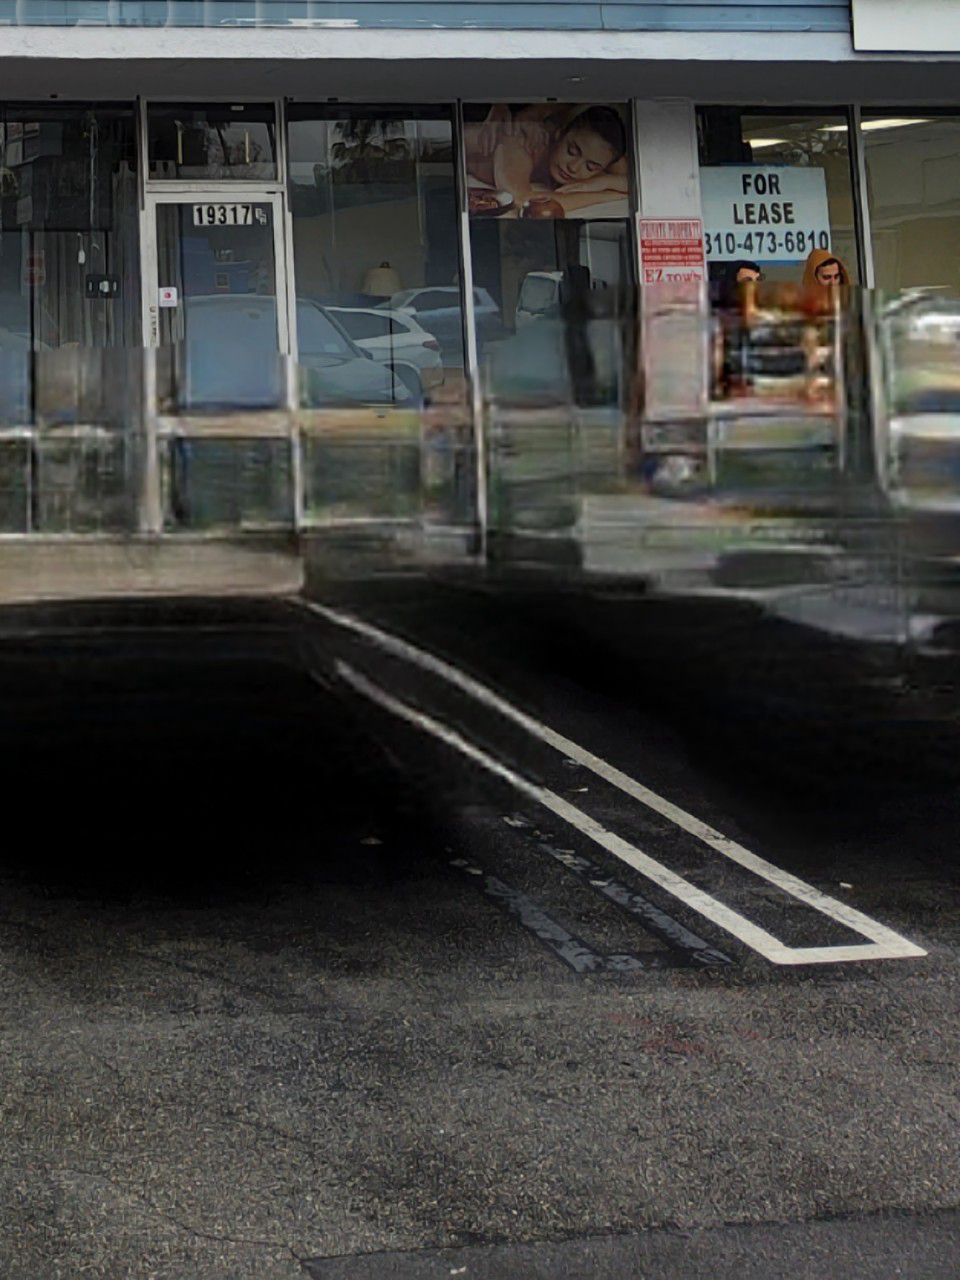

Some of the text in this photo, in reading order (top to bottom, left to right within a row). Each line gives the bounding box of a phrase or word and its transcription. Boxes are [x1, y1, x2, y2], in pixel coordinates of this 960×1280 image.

[742, 174, 781, 195] FOR
[196, 206, 250, 224] 19317
[733, 202, 795, 224] LEASE
